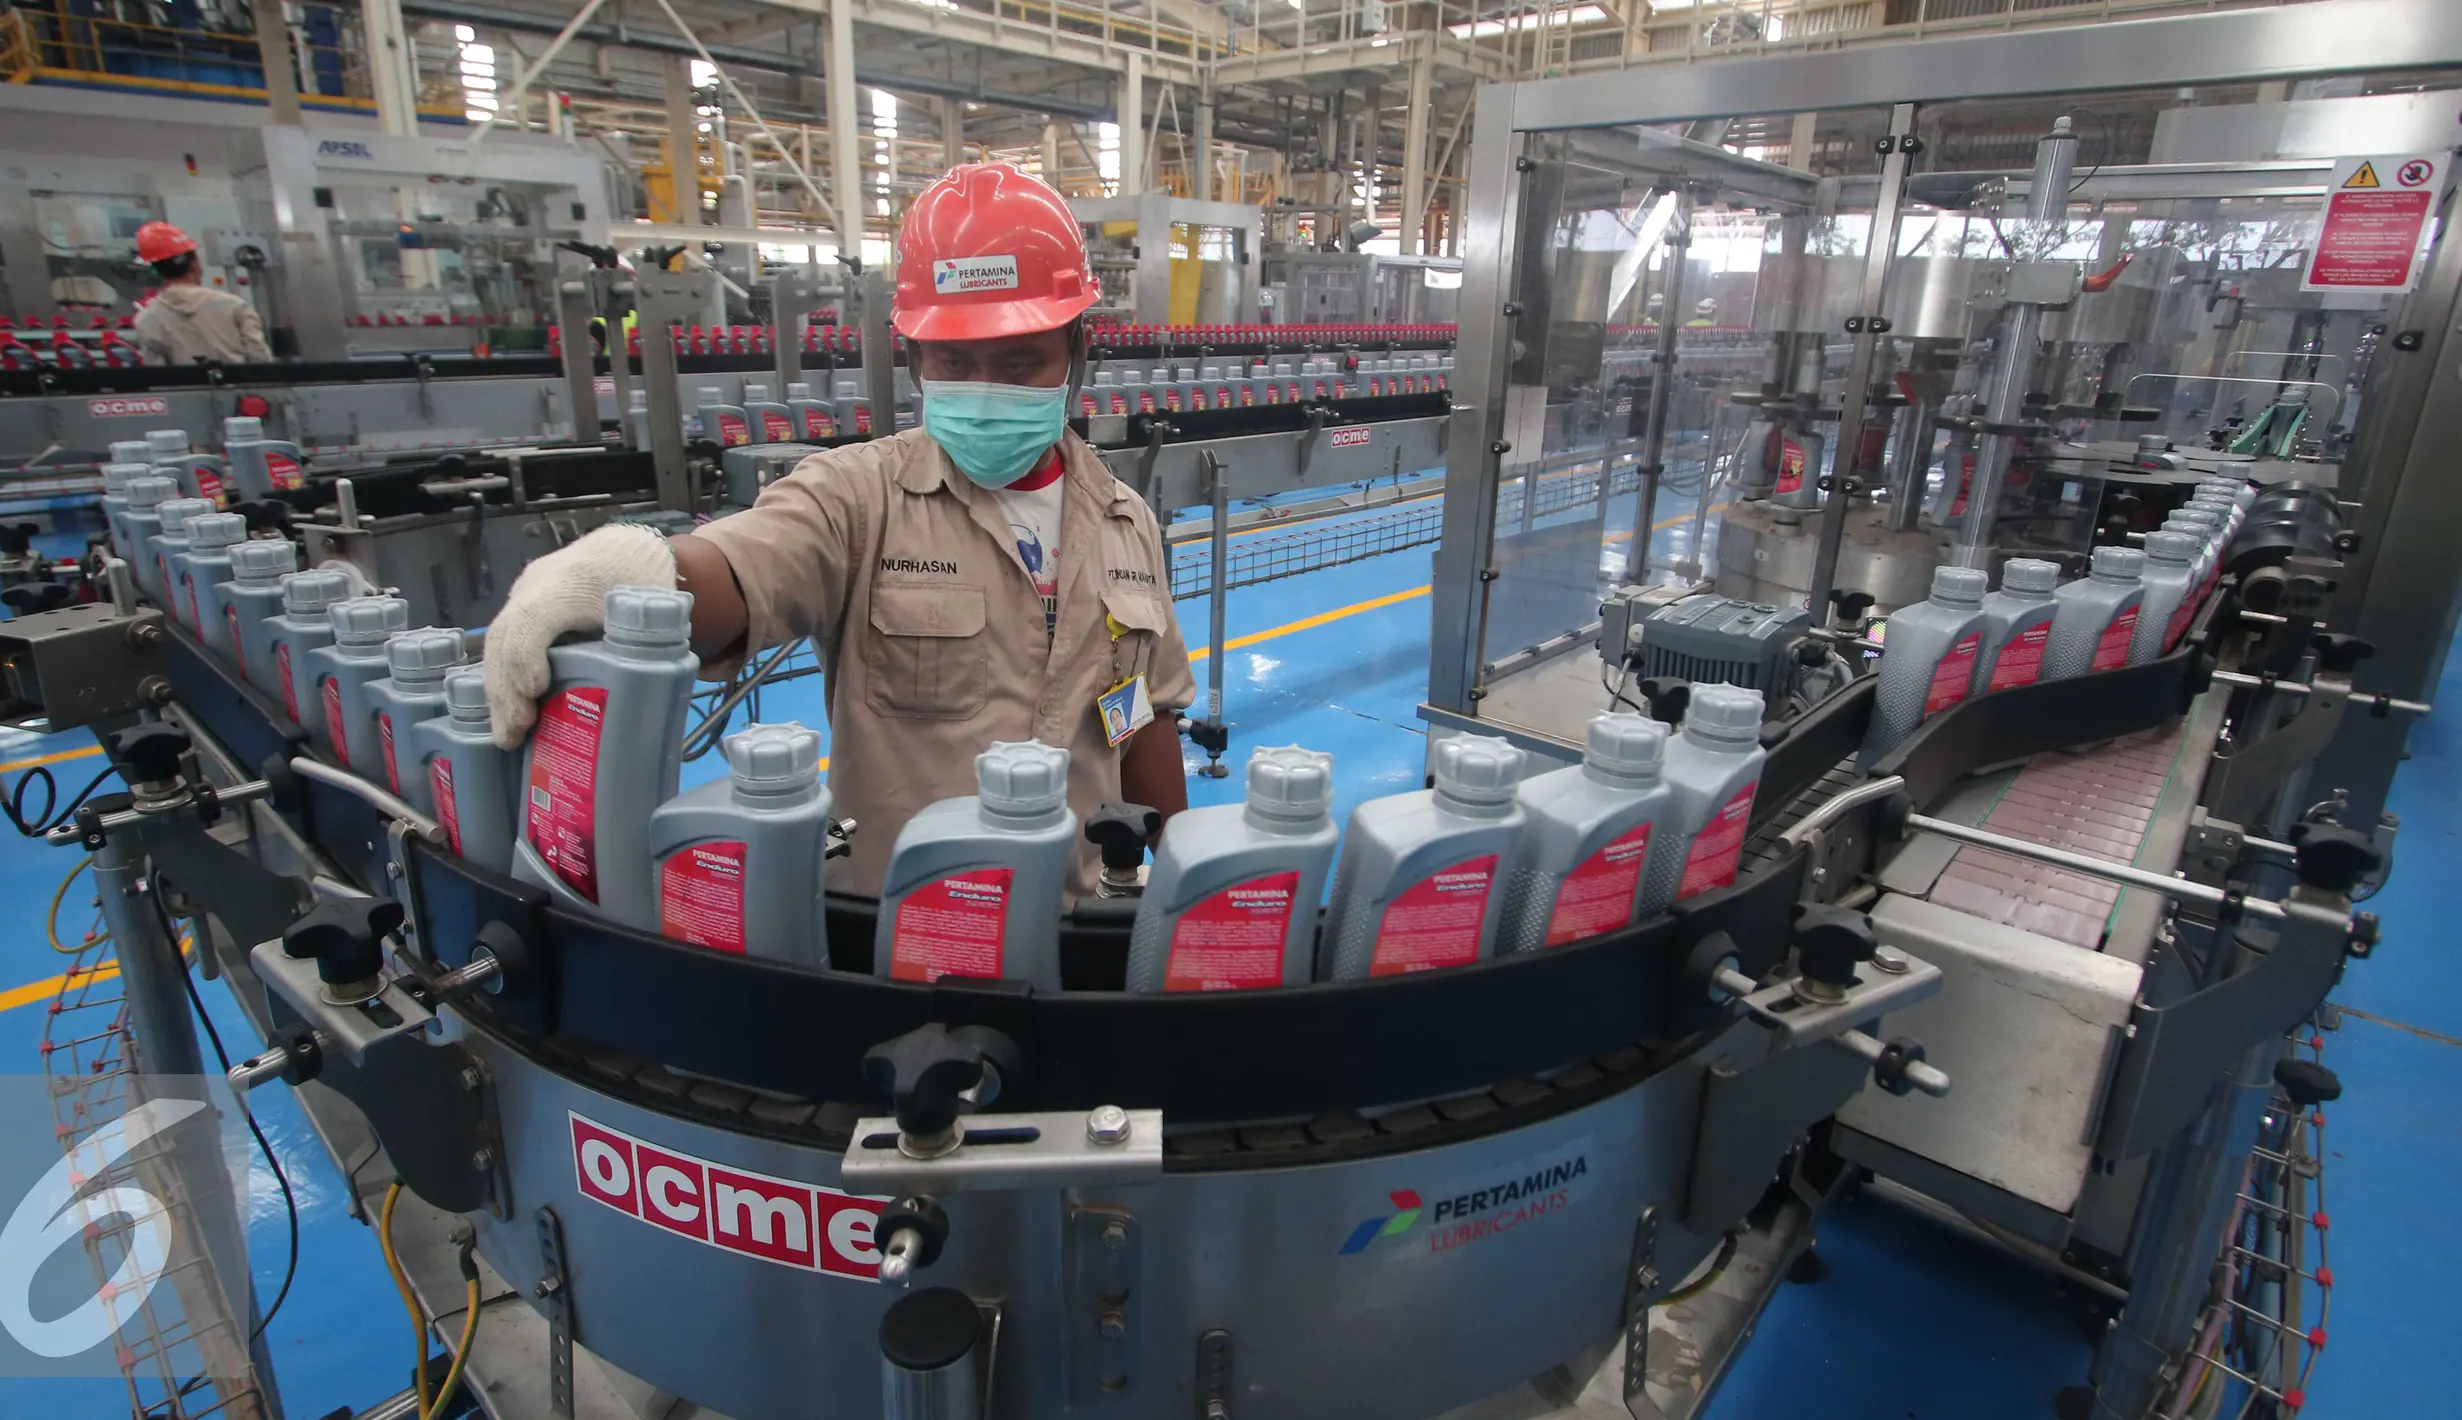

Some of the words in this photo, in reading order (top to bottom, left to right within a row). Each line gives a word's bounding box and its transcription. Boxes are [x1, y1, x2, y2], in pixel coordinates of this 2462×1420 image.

[958, 266, 1016, 279] PERTAMINA
[960, 278, 1008, 289] LUBRICANTS
[1333, 429, 1369, 445] ocme
[881, 558, 957, 575] NURHASAN
[566, 692, 601, 713] PERTAMINA
[692, 849, 741, 867] PERTAMINA
[696, 860, 740, 875] Enduro
[1433, 871, 1488, 883] PERTAMINA
[944, 879, 1004, 894] PERTAMINA
[1227, 889, 1289, 899] PERTAMINA
[948, 890, 1002, 902] Enduro
[1230, 900, 1288, 908] Enduro
[1434, 1156, 1588, 1223] PERTAMINA
[581, 1138, 884, 1265] ocme
[1430, 1188, 1568, 1252] LUBRICANTS
